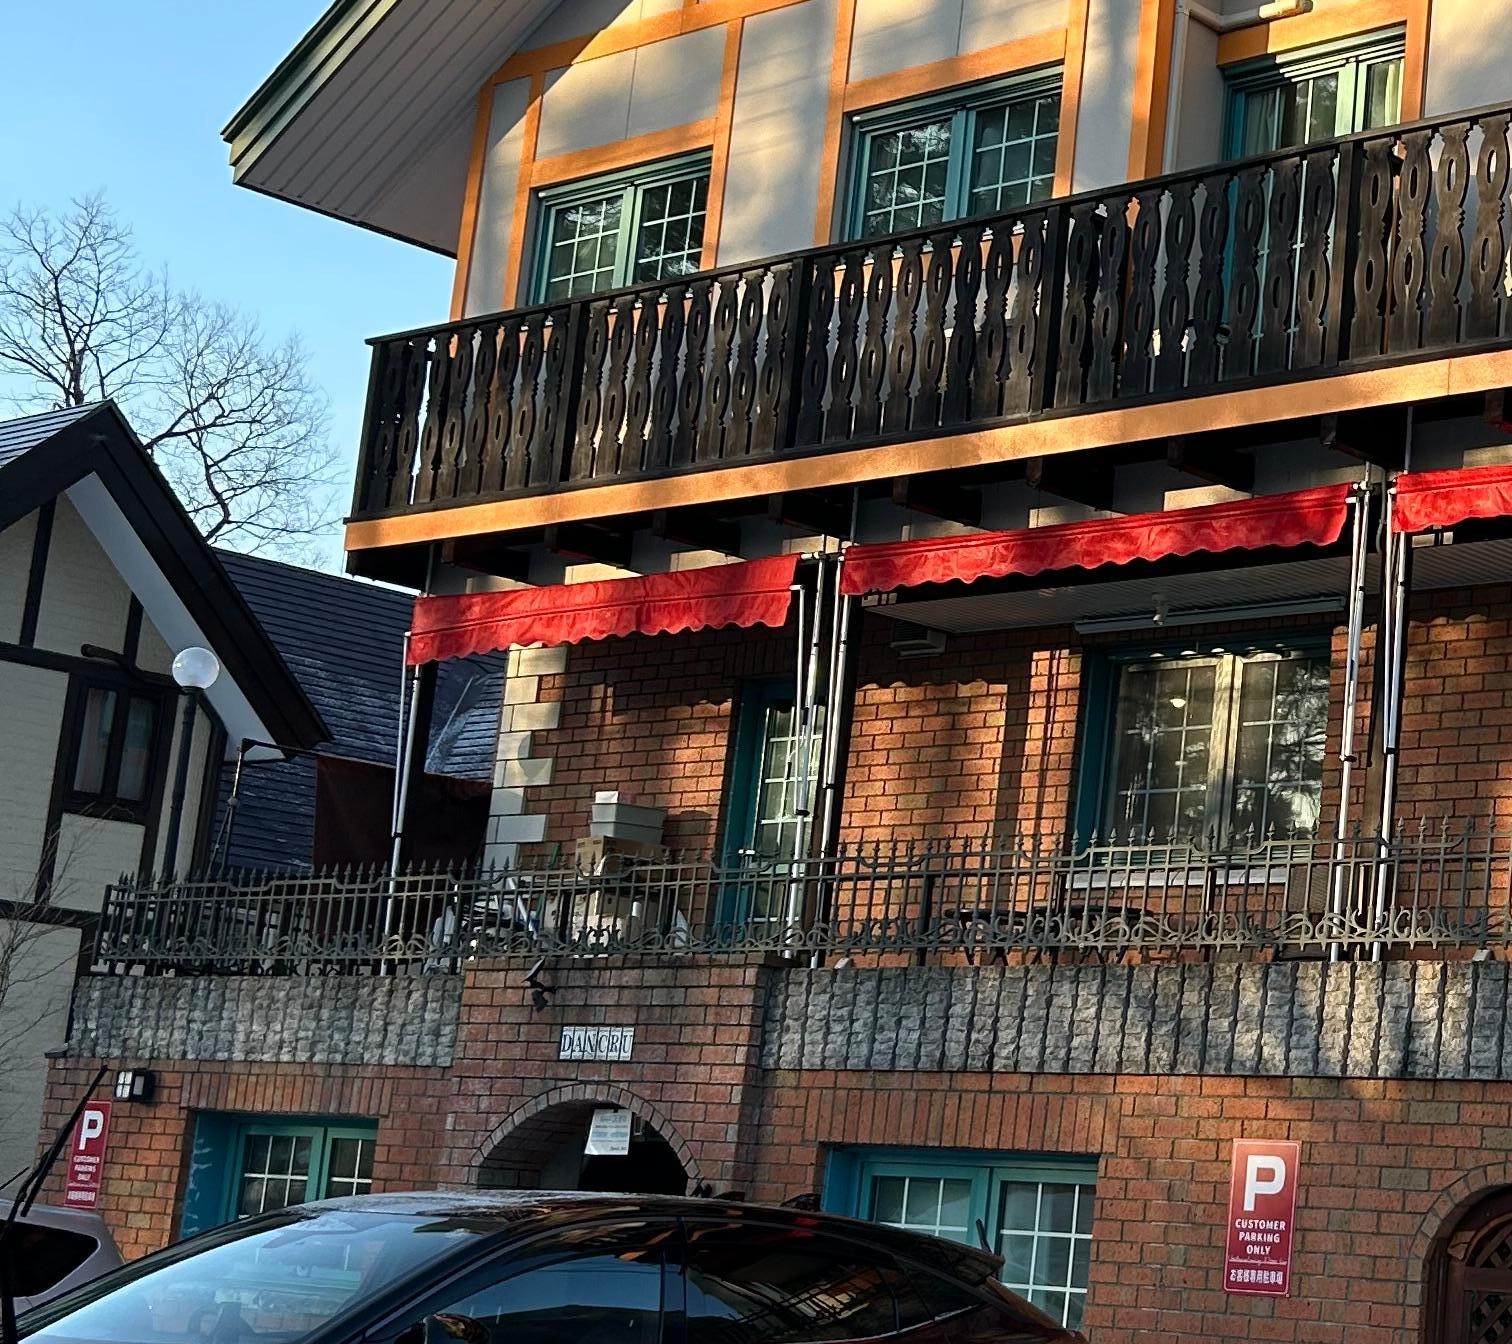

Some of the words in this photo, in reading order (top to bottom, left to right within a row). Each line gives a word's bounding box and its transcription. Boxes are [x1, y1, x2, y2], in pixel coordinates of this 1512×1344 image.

[562, 1033, 632, 1055] DANCRU
[78, 1110, 104, 1150] P
[1243, 1154, 1286, 1212] P
[1235, 1218, 1286, 1231] CUSTOMER
[1238, 1231, 1281, 1243] PARKING
[1246, 1244, 1272, 1255] ONLY
